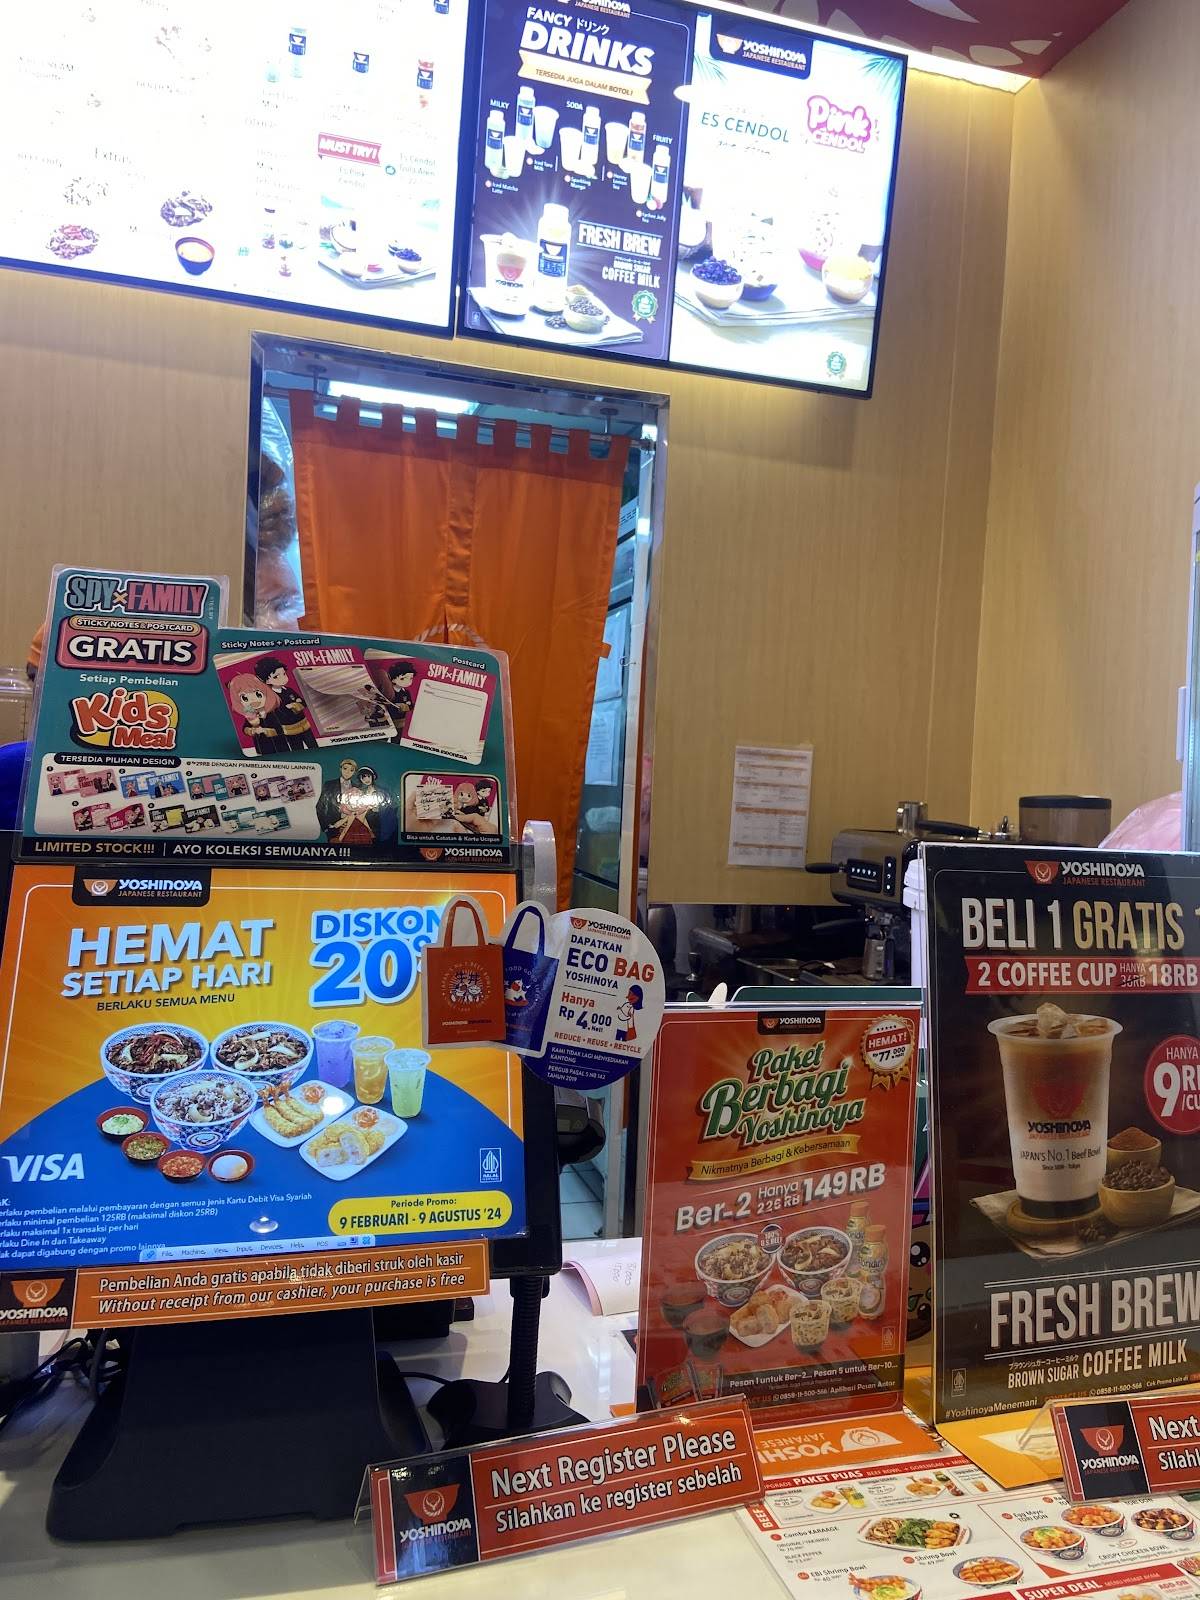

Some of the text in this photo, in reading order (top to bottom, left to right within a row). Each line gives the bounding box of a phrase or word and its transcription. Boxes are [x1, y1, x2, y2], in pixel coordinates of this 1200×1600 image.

[527, 7, 610, 35] FANCY ドリンク
[520, 21, 655, 75] DRINKS
[743, 39, 806, 64] YOSHINOYA
[536, 69, 633, 96] TERSEDIA JUGA DALAM BOTOL!
[490, 99, 509, 109] MILKY
[566, 101, 583, 110] SODA
[702, 111, 789, 143] ES CENDOL
[653, 134, 673, 144] FRUITY
[579, 224, 662, 257] FRESH BREW
[602, 266, 660, 288] COFFEE MILK
[77, 619, 109, 627] STICKY
[146, 623, 194, 631] POSTCARD
[69, 636, 192, 664] GRATIS
[222, 641, 248, 649] Sticky
[250, 640, 275, 648] Notes
[284, 637, 320, 646] Postcard
[452, 656, 485, 670] Postcard
[80, 674, 178, 686] Setiap Pembelian
[73, 688, 171, 734] Kids
[112, 726, 176, 749] Meal
[35, 842, 154, 854] LIMITED STOCK!!!
[444, 848, 502, 856] YOSHINOYA
[1060, 861, 1145, 877] YOSHINOYA
[118, 879, 202, 891] YOSHINOYA
[587, 920, 631, 936] YOSHINOYA
[961, 897, 1185, 950] BELI 1 GRATIS
[67, 919, 274, 967] HEMAT
[571, 935, 622, 953] DAPATKAN
[566, 948, 655, 982] ECO BAG
[978, 961, 1198, 987] 2 COFFEE CUP HANYA 18RB
[60, 961, 271, 997] SETIAP HARI
[565, 970, 619, 989] YOSHINOYA
[96, 994, 235, 1011] BERLAKU SEMUA MENU
[561, 992, 595, 1008] Hanya
[554, 1032, 641, 1054] REDUCE REUSE RECYCLE
[868, 1032, 907, 1048] HEMAT!
[566, 1049, 581, 1057] TIDAK
[753, 1041, 826, 1078] Paket
[1166, 1047, 1198, 1060] HANYA
[702, 1058, 851, 1138] Berbagi
[1153, 1062, 1181, 1117] 9
[740, 1098, 867, 1146] Yoshinoya
[1028, 1120, 1091, 1133] YOSHINOYA
[2, 1153, 85, 1182] VISA
[701, 1140, 850, 1176] Nikmatnya Berbagi & Kebersamaan
[758, 1181, 799, 1199] Hanya
[391, 1198, 457, 1208] Periode Promo:
[339, 1218, 347, 1229] 9
[350, 1213, 409, 1228] FEBRUARI
[419, 1213, 426, 1224] 9
[430, 1209, 481, 1223] AGUSTUS
[100, 1253, 464, 1293] Pembelian Anda gratis apabila tidak diberi struk oleh kasir
[99, 1272, 464, 1314] Without receipt from our cashier, your purchase is free
[990, 1282, 1100, 1347] FRESH
[1008, 1339, 1188, 1388] BROWN SUGAR COFFEE MILK
[945, 1397, 1038, 1419] #YoshinoyaMenemani
[761, 1432, 824, 1446] JAPANESE
[491, 1429, 737, 1498] Next Register Please
[1080, 1454, 1139, 1470] YOSHINOYA
[793, 1474, 830, 1486] PAKET
[831, 1471, 863, 1480] PUAS
[495, 1462, 742, 1534] Silahkan ke register sebelah
[1024, 1585, 1066, 1600] SUPER
[1067, 1580, 1103, 1592] DEAL
